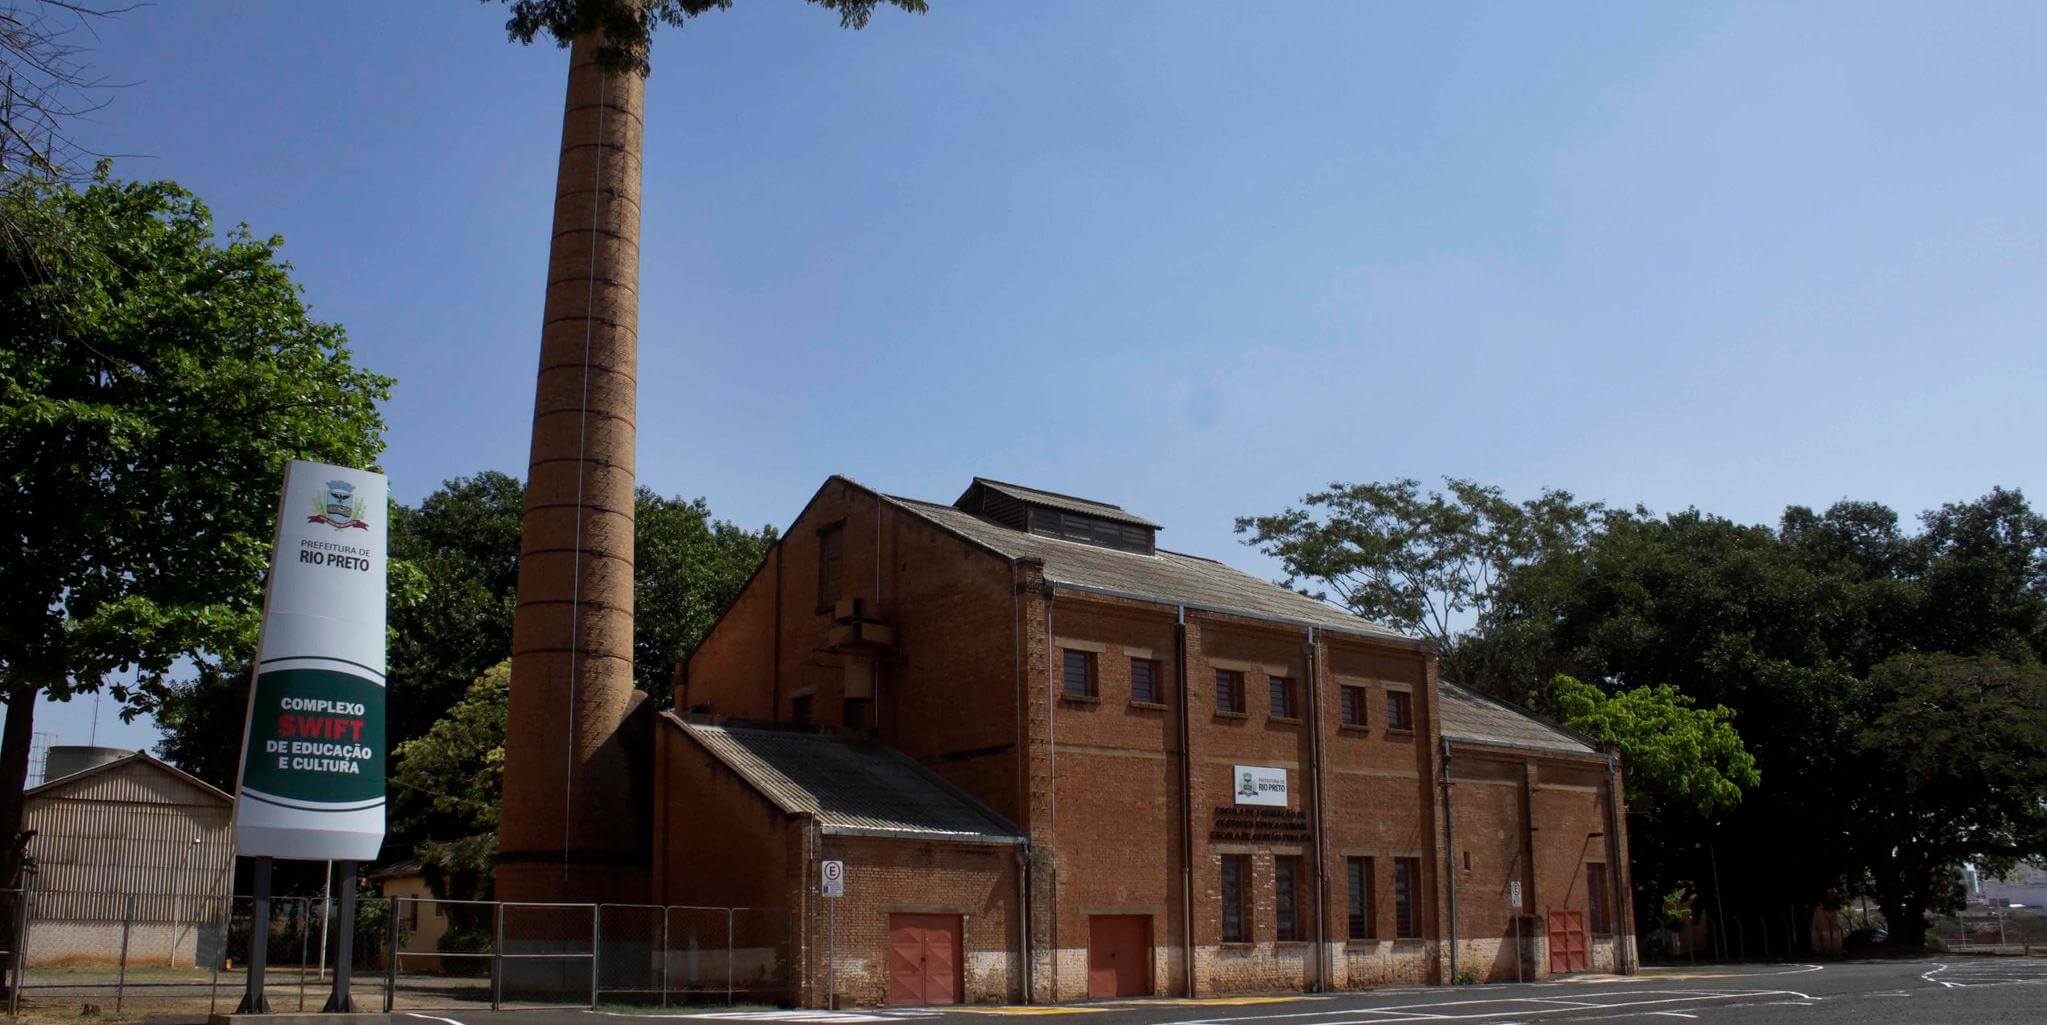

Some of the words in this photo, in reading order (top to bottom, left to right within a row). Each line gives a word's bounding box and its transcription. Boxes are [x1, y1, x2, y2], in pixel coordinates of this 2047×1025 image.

[301, 539, 356, 555] PREFEITURA
[358, 548, 371, 557] DE
[300, 550, 324, 565] RIO
[327, 555, 370, 572] PRETO
[281, 697, 365, 716] COMPLEXO
[278, 714, 365, 742] SWIFT
[266, 740, 289, 753] DE
[291, 741, 372, 761] EDUCAÇÃO
[278, 756, 289, 769] E
[292, 757, 360, 774] CULTURA
[1258, 783, 1268, 792] RIO
[1268, 784, 1286, 793] PRETO
[829, 866, 836, 876] E
